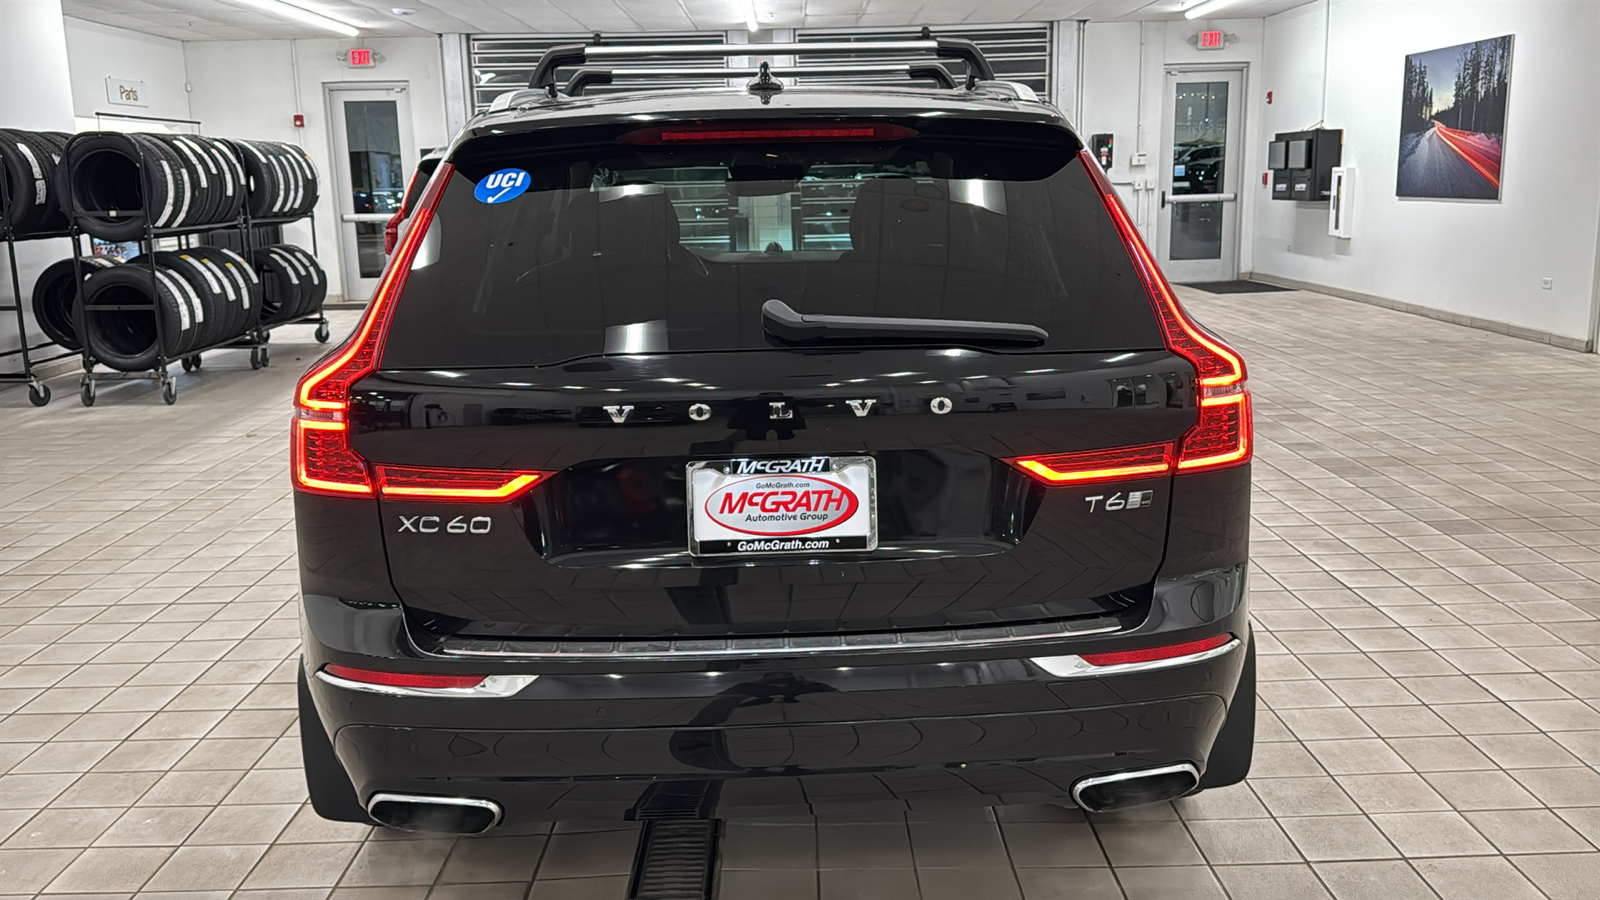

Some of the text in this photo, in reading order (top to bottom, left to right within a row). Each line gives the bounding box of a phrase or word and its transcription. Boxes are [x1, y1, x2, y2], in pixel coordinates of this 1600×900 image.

[1202, 31, 1222, 47] EXIT
[350, 49, 370, 65] EXIT
[119, 84, 139, 101] Parts
[485, 171, 526, 189] UCI
[603, 396, 953, 423] VOLVO
[755, 481, 811, 490] GoMcGrath.com
[1085, 492, 1125, 514] T6
[745, 512, 829, 523] Automotive Group
[737, 538, 830, 552] GoMcGrath.com
